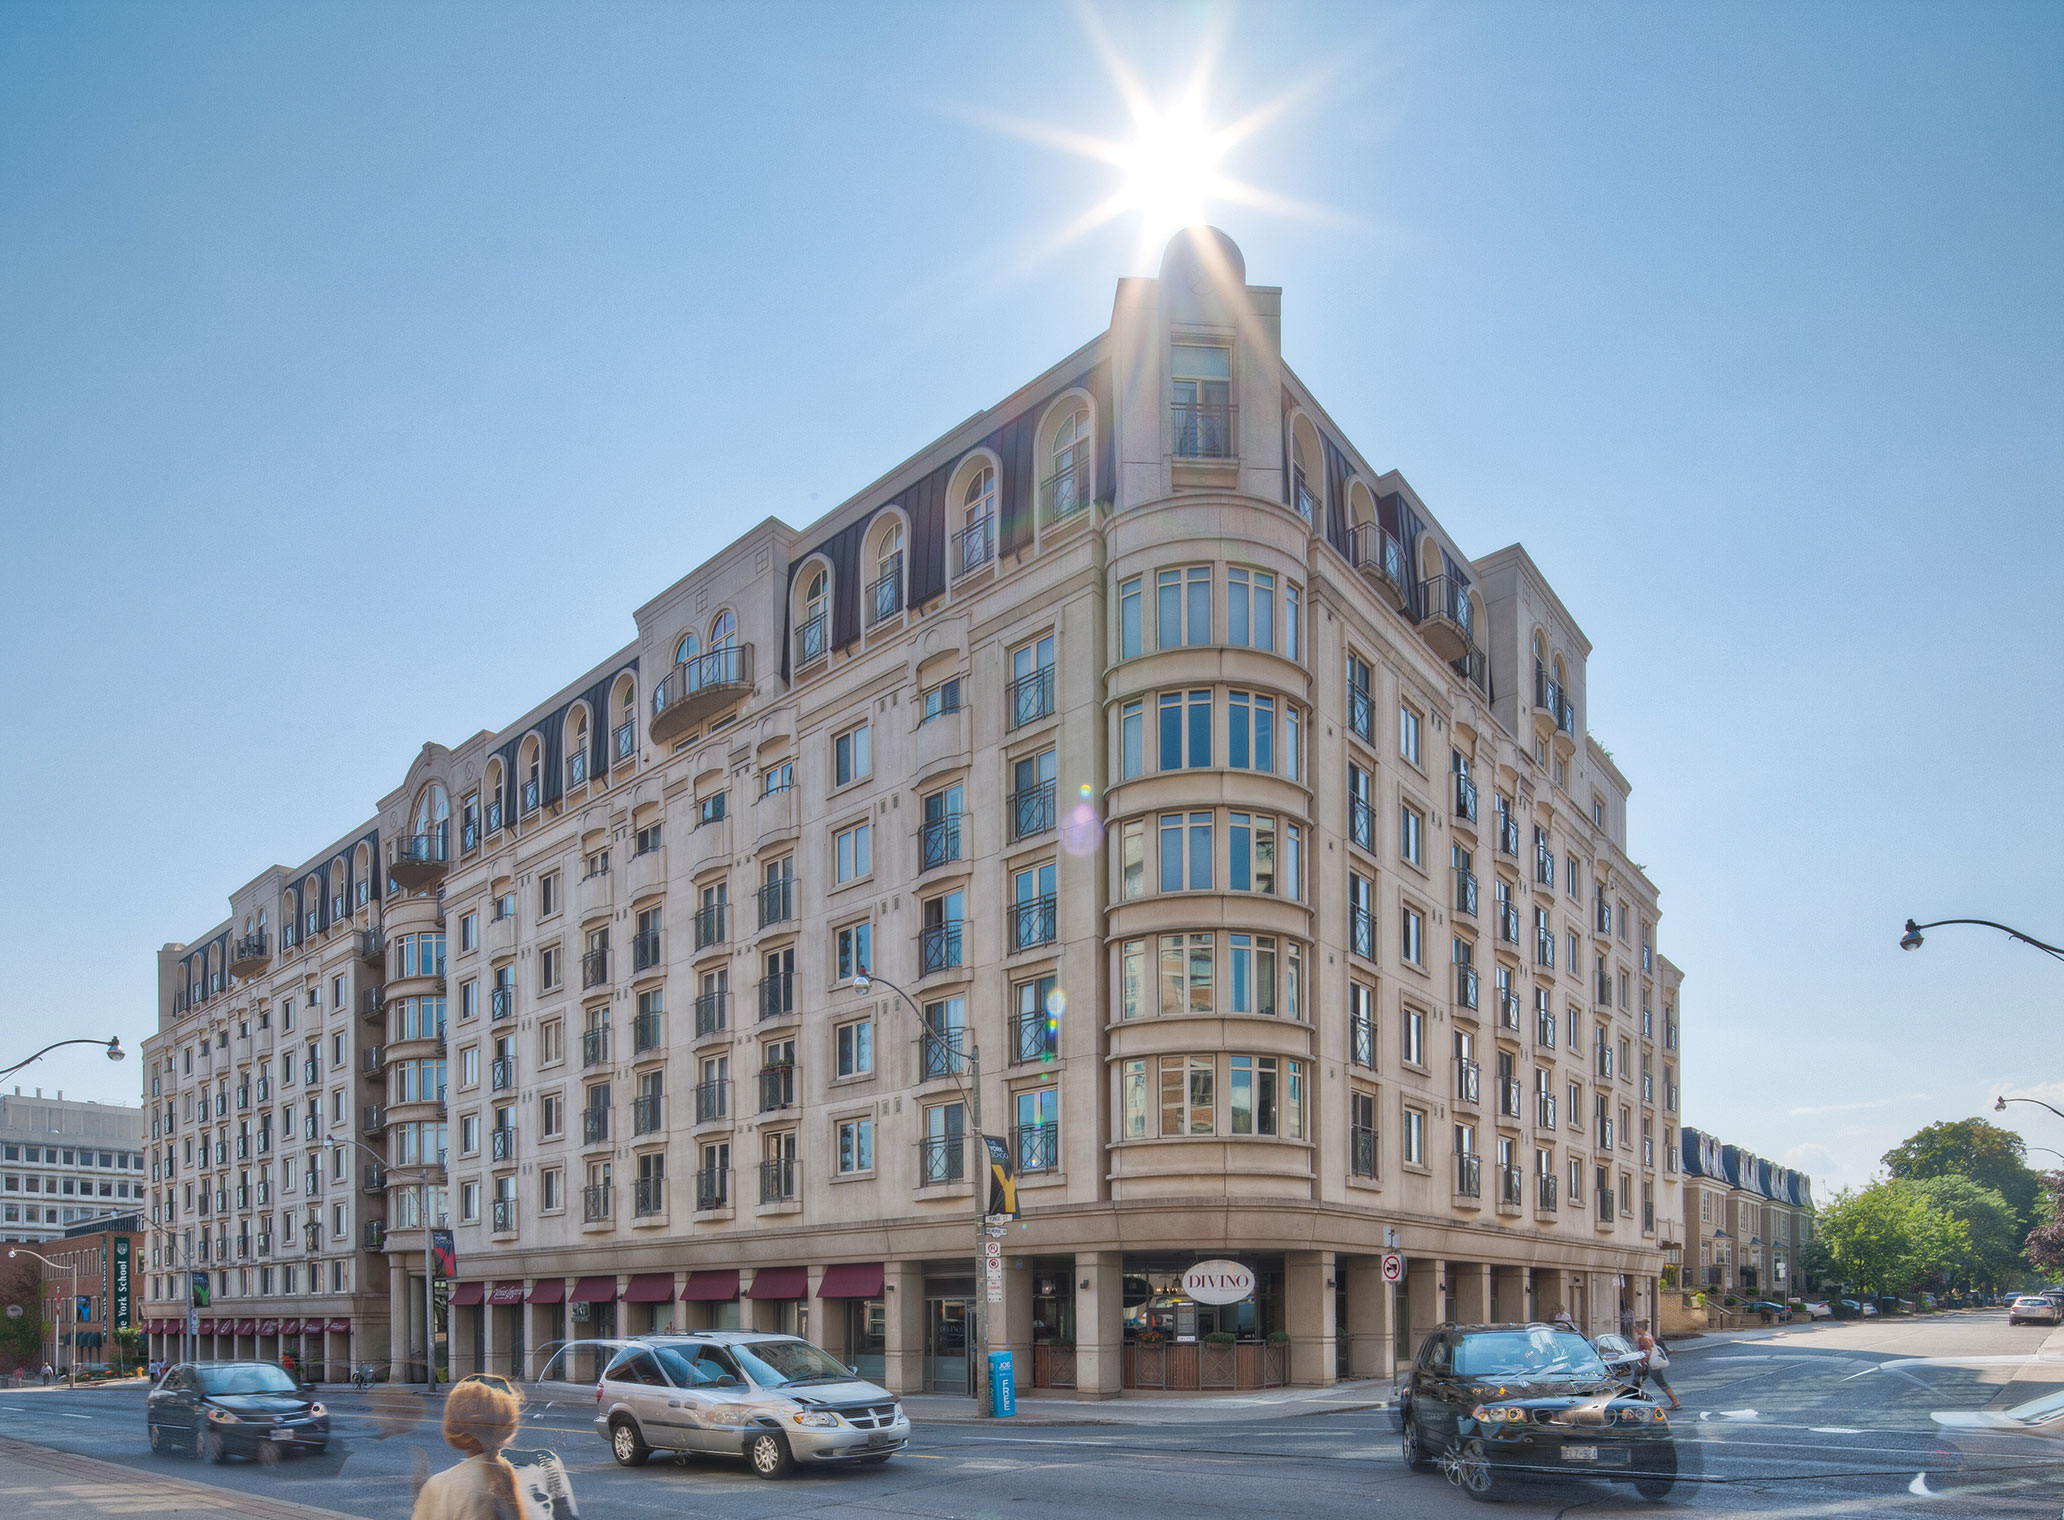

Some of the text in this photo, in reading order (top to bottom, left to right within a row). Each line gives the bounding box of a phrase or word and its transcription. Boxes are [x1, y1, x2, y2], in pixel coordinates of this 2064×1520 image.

[117, 1260, 128, 1292] School
[1189, 1275, 1249, 1288] DIVINO
[117, 1296, 128, 1317] York
[1002, 1380, 1011, 1411] FREE
